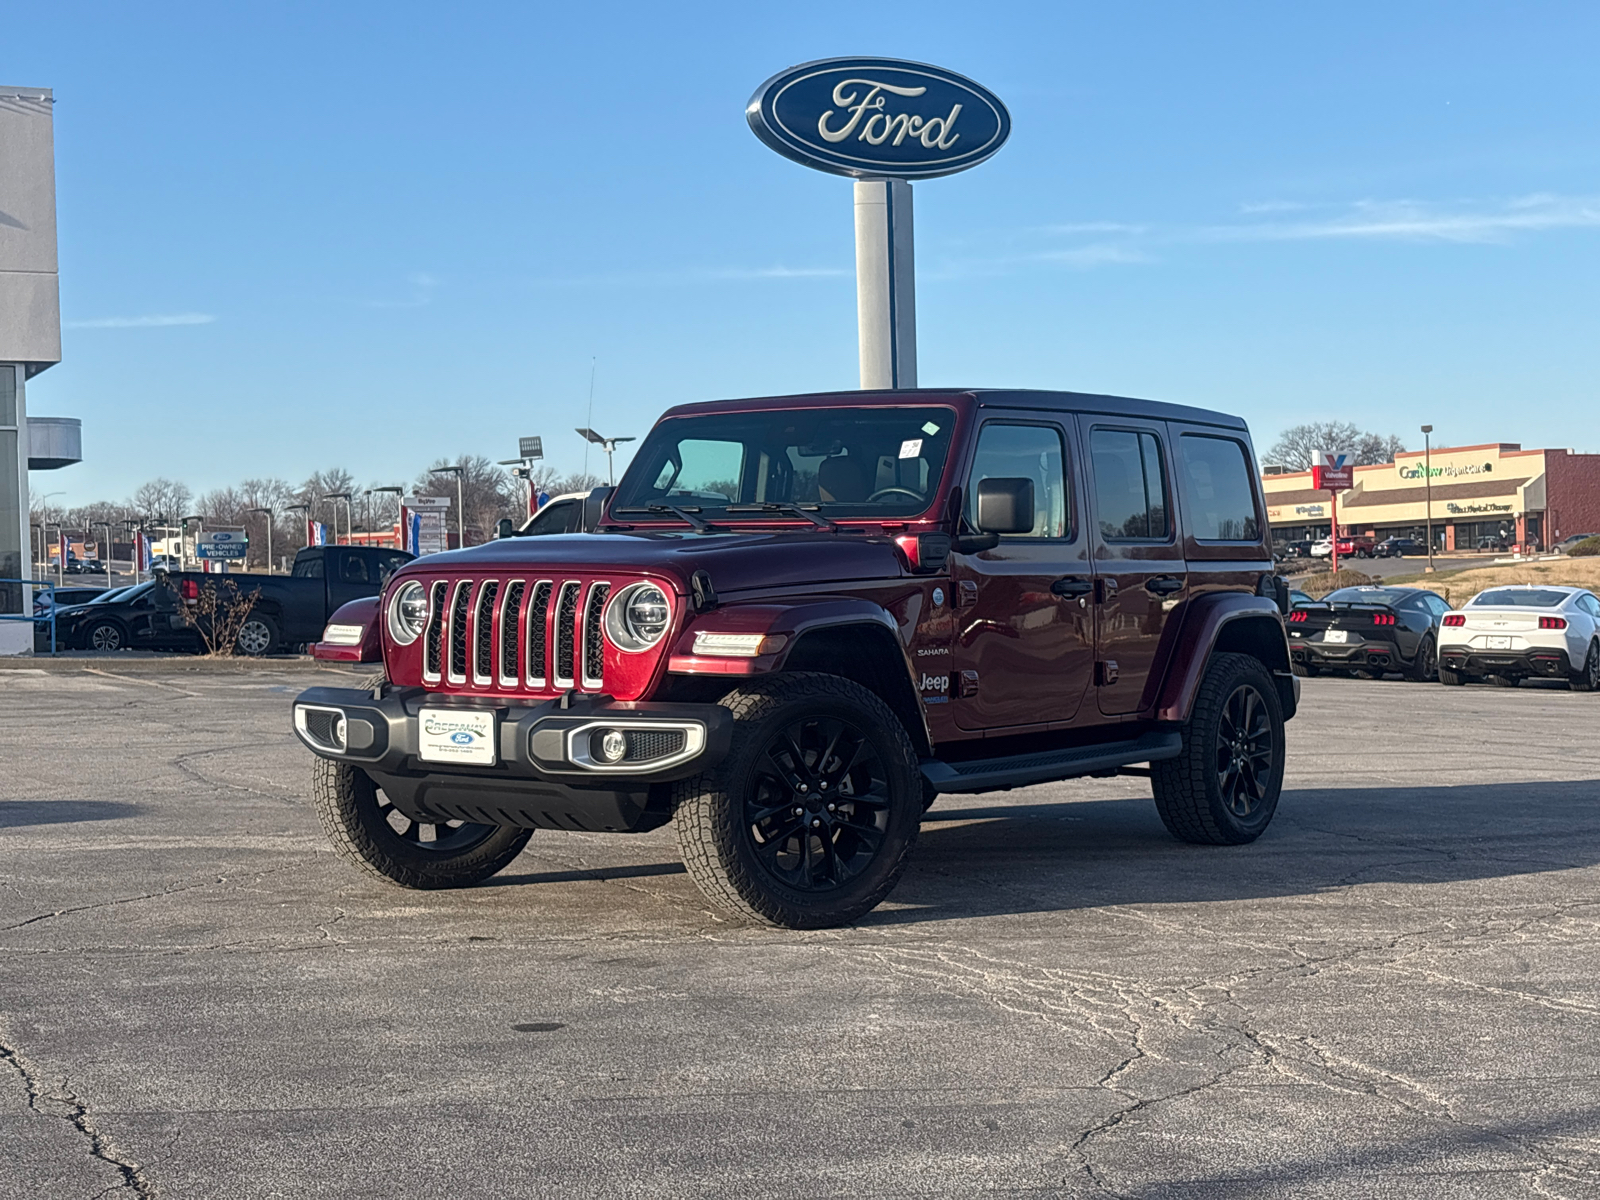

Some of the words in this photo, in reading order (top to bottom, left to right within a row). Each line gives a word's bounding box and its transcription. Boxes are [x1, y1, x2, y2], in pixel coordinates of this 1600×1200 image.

[818, 79, 963, 150] Ford
[917, 648, 949, 657] SAHARA
[920, 673, 949, 693] Jeep
[454, 733, 470, 743] Ford
